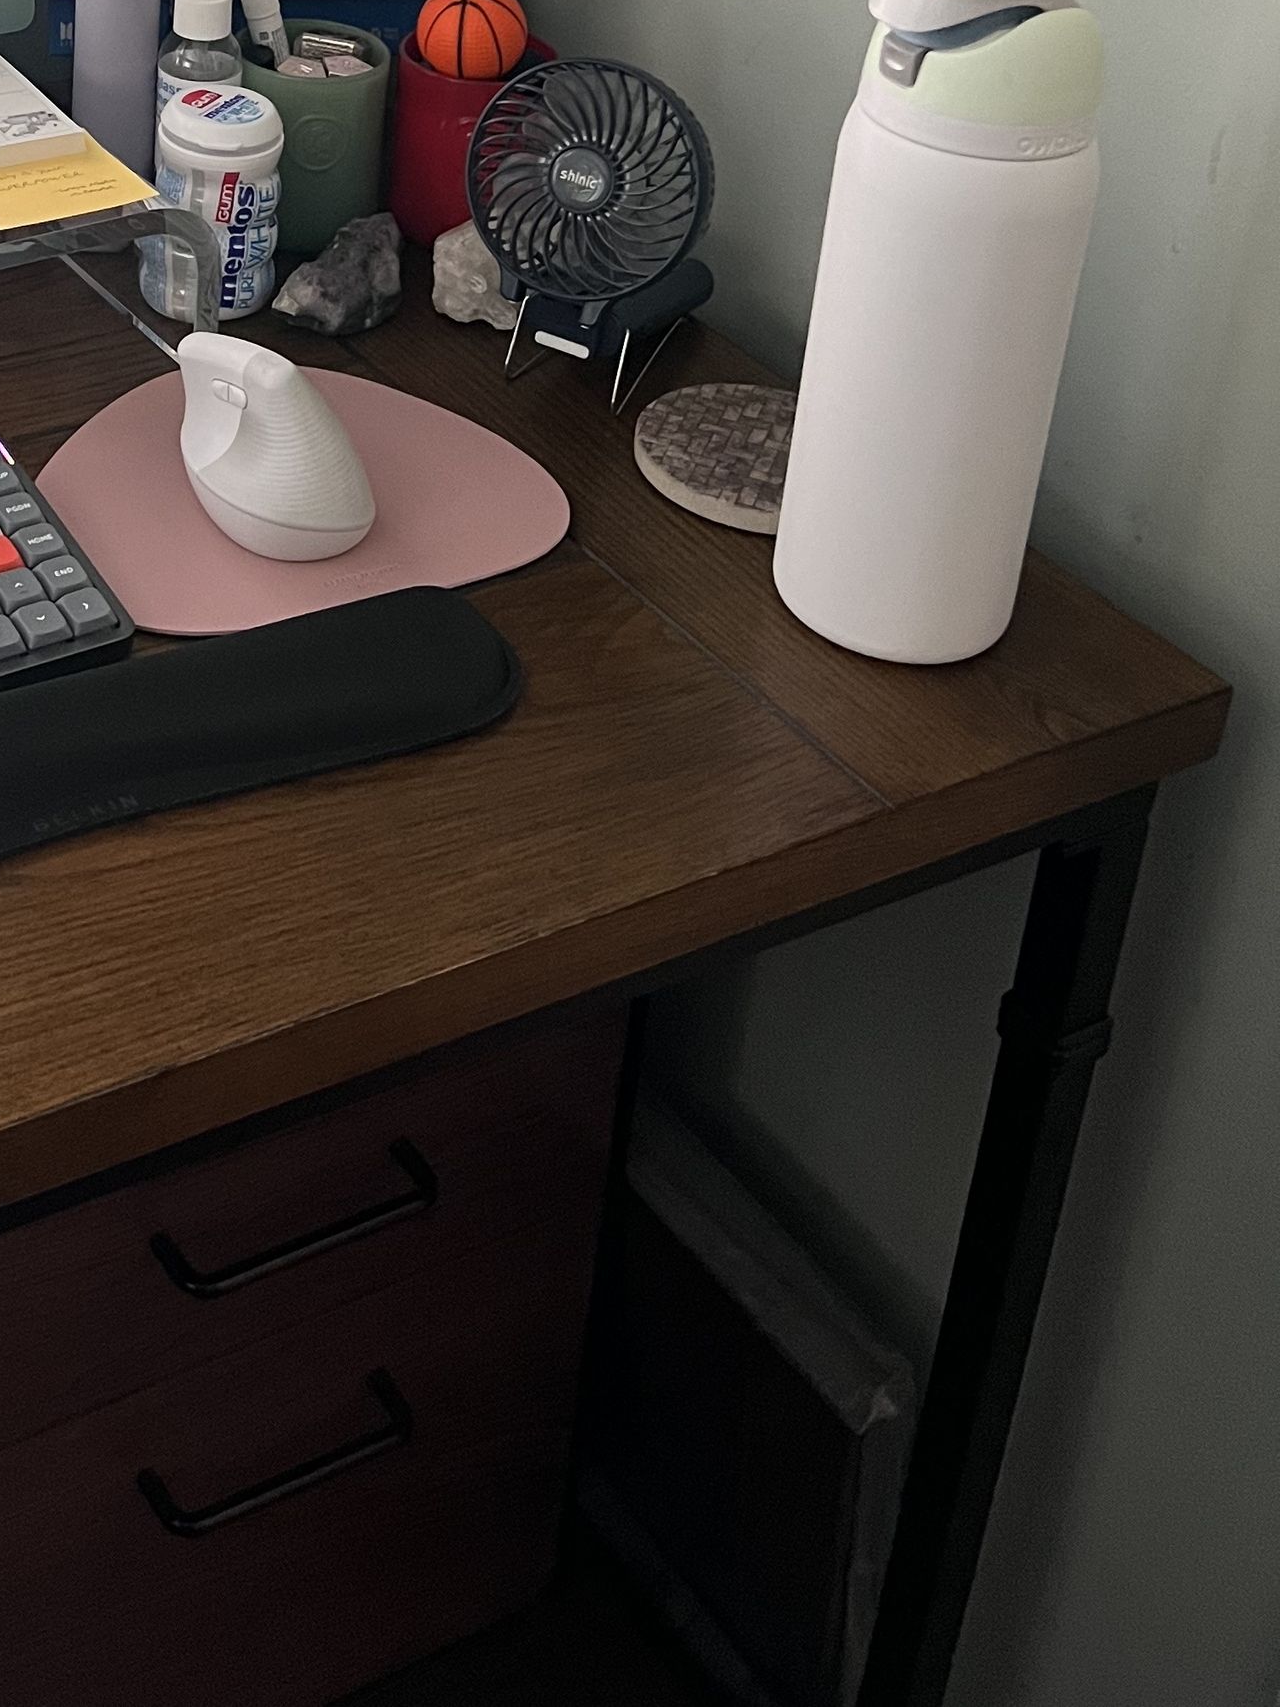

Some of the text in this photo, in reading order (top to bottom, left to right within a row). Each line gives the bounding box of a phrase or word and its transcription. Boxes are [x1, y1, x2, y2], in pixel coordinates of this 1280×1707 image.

[204, 94, 247, 119] mentos
[560, 169, 598, 189] shinic
[219, 184, 233, 221] GUM
[221, 184, 256, 310] mentos
[237, 185, 275, 310] PURE WHITE
[5, 501, 32, 515] PGDN
[27, 532, 54, 546] HOME
[54, 567, 74, 577] END
